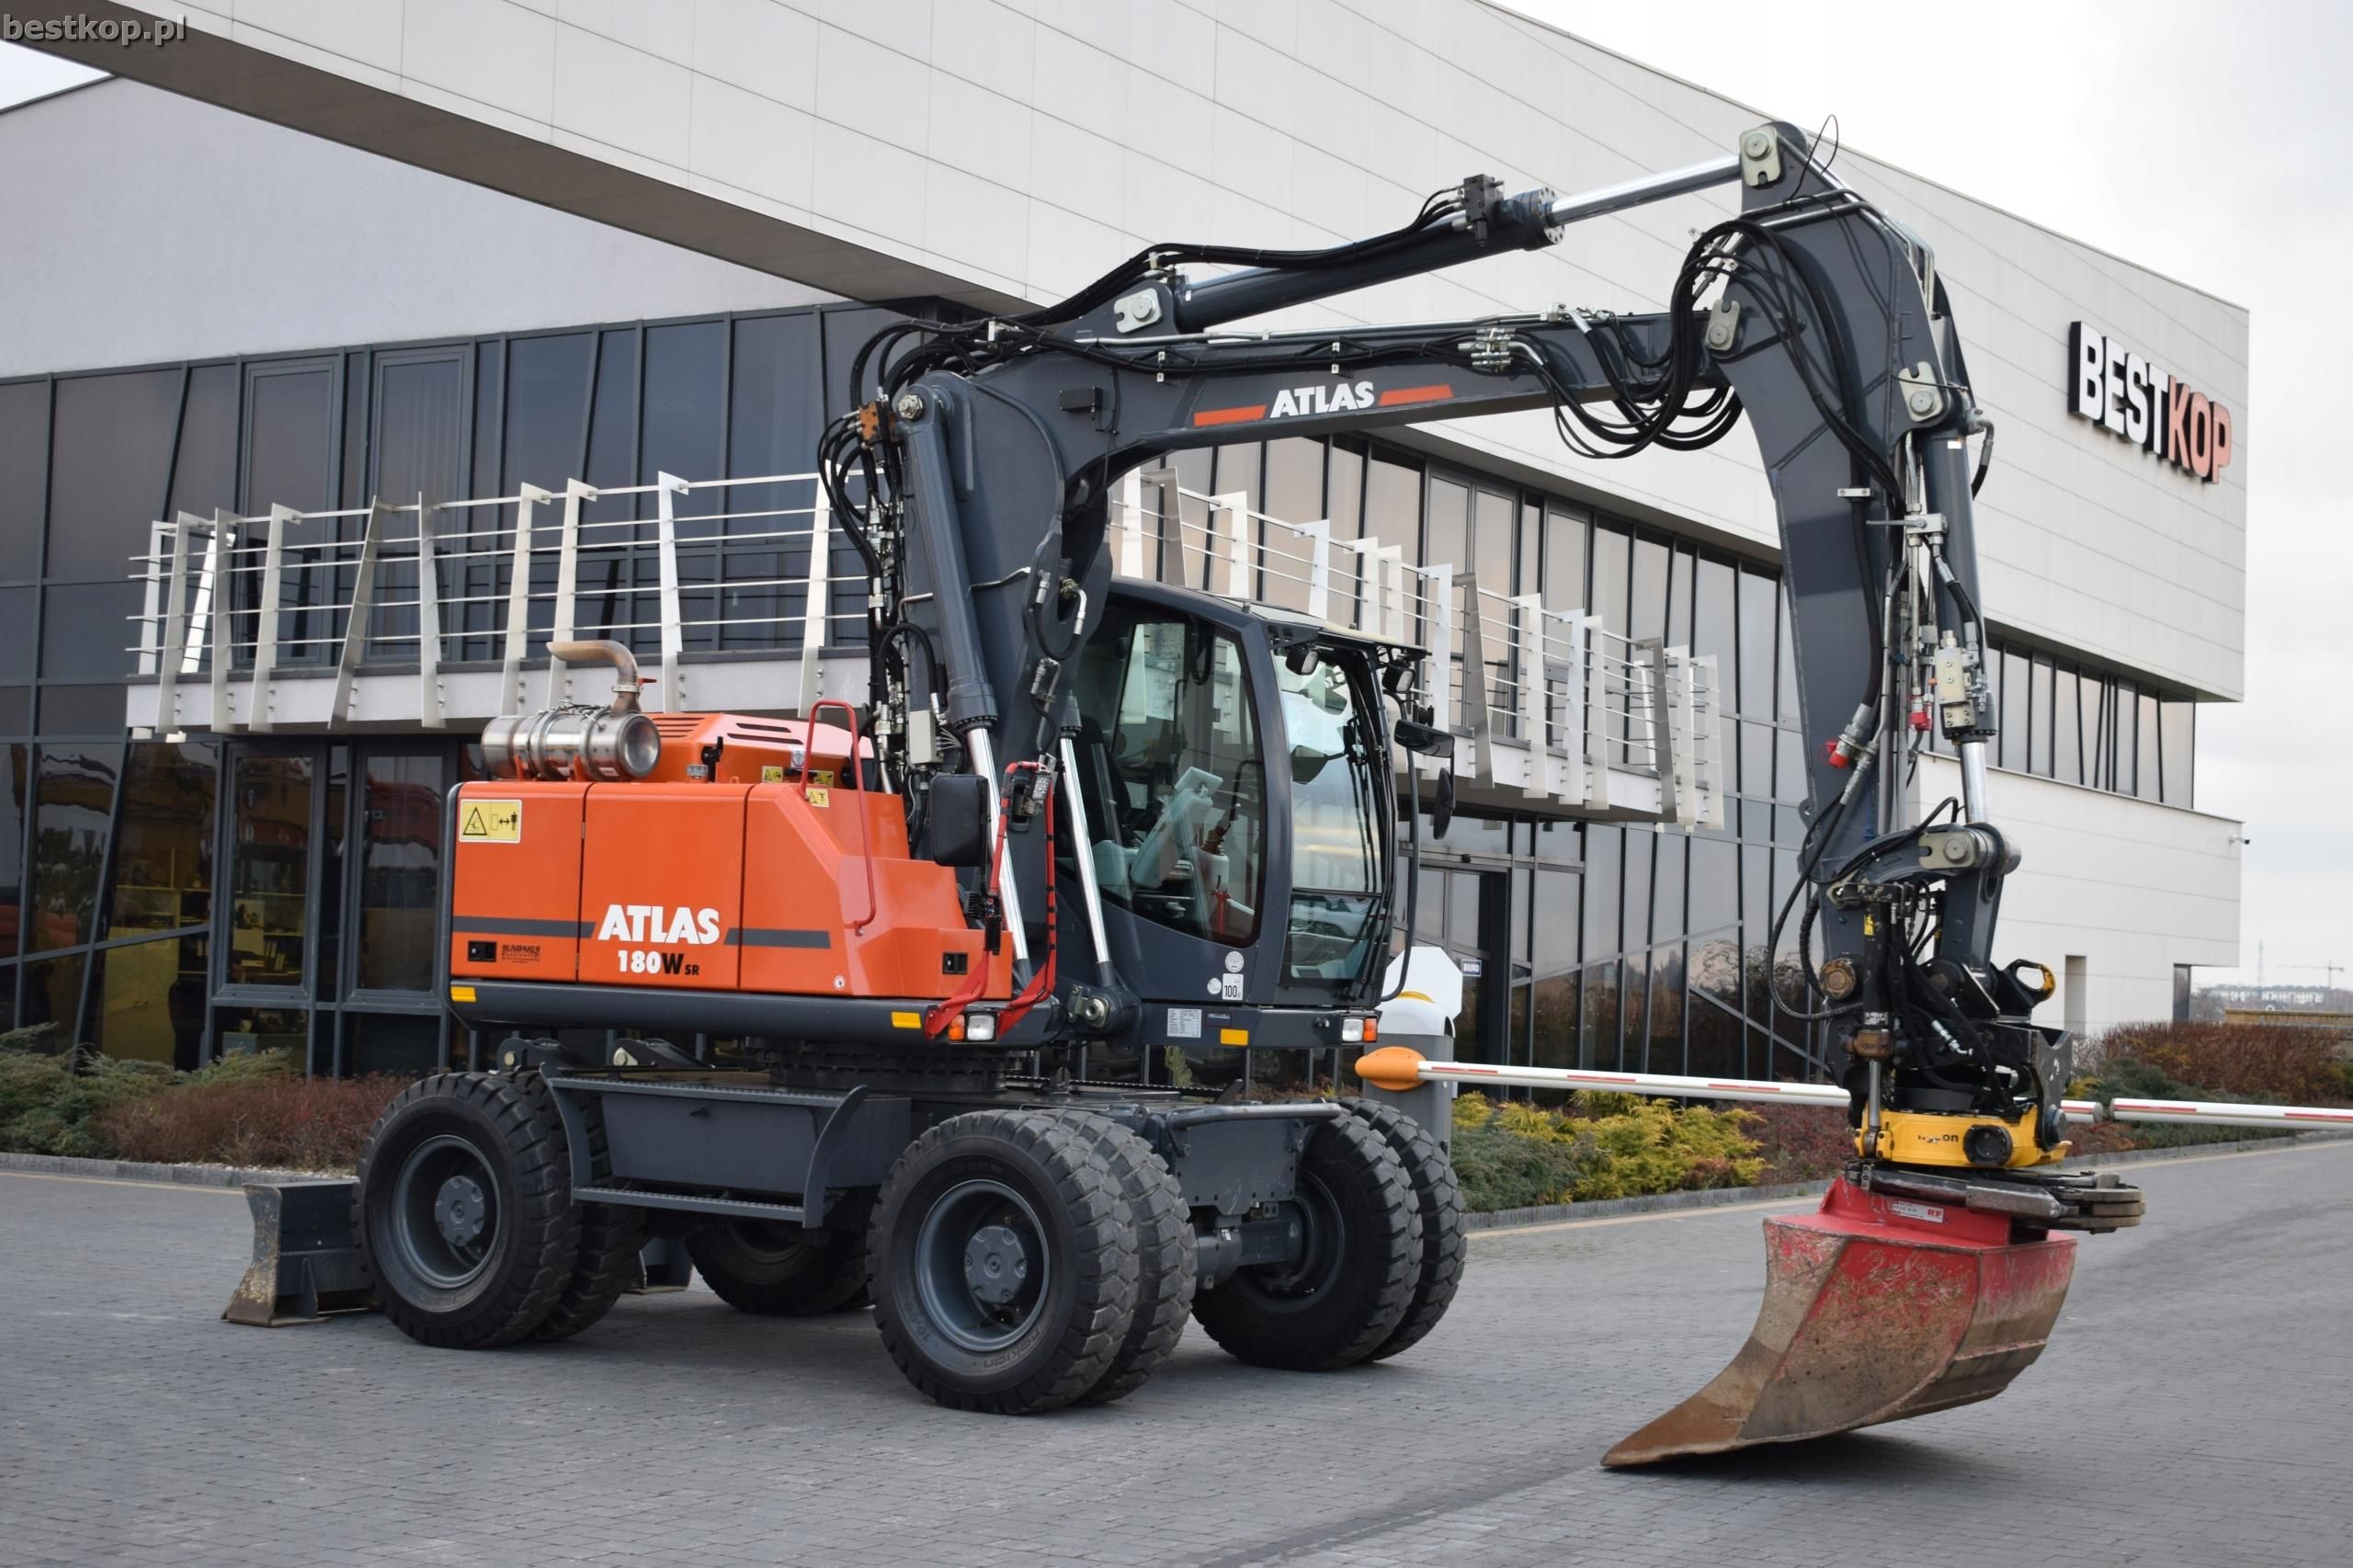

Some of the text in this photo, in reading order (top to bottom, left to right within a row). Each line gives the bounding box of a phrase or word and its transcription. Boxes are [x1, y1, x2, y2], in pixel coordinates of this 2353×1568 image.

[1269, 381, 1375, 418] ATLAS
[2069, 321, 2232, 484] BESTKOP
[597, 904, 721, 945] ATLAS
[1223, 984, 1238, 998] 100
